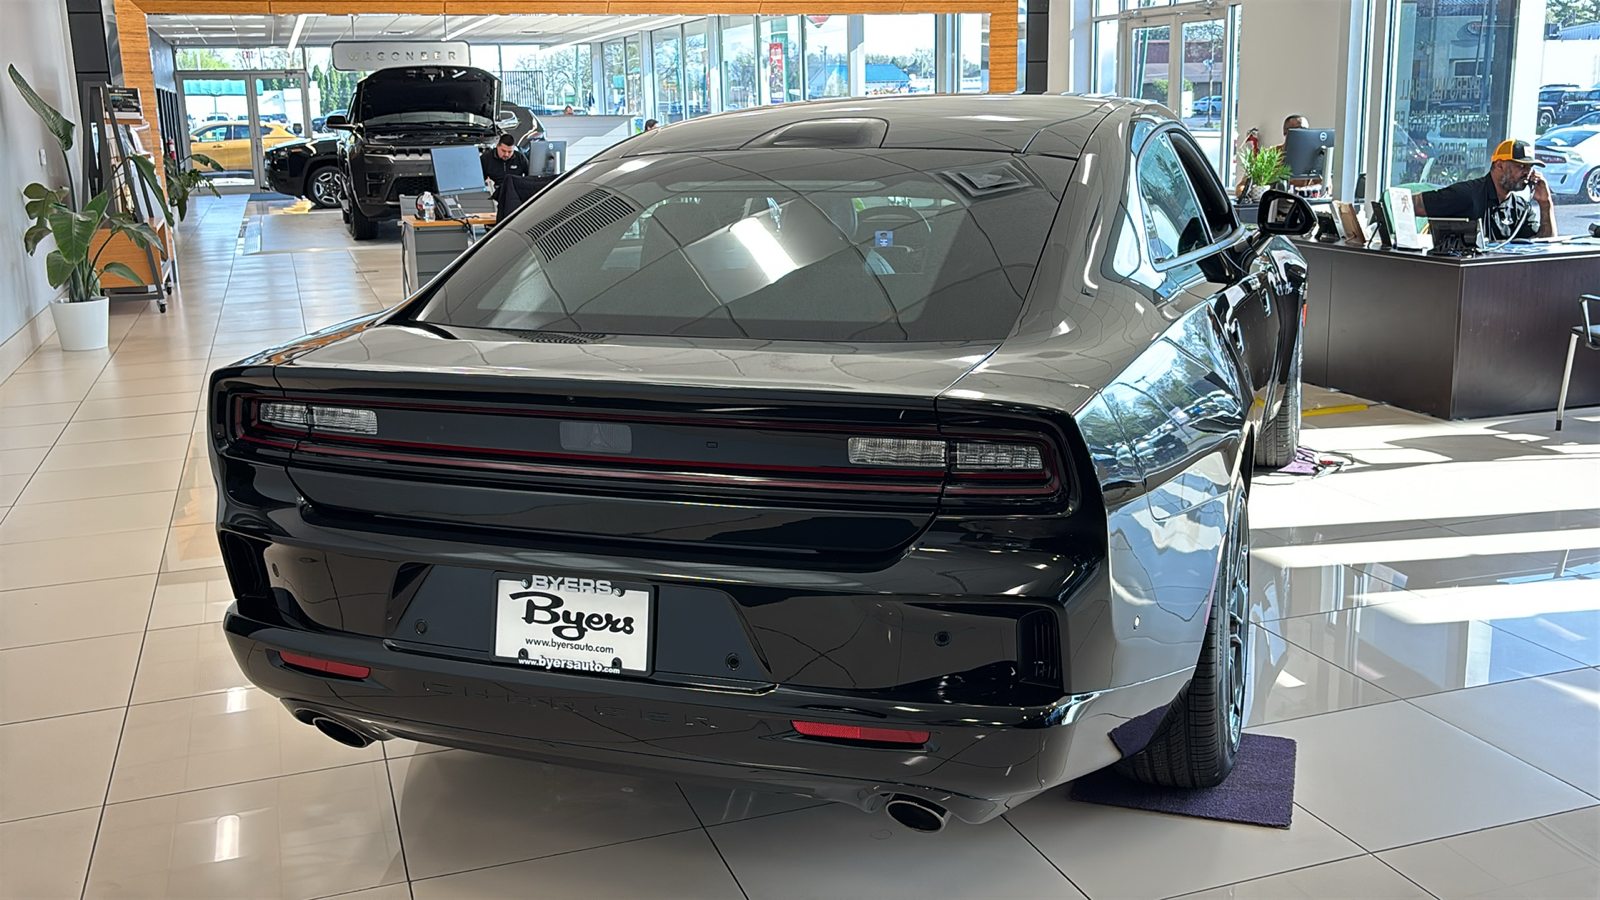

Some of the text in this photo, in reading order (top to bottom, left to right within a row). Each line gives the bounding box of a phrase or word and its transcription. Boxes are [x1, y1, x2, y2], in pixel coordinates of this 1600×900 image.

[532, 574, 613, 595] BYERS
[509, 591, 635, 641] Byers
[525, 637, 614, 654] www.byersauto.com
[518, 654, 621, 674] www.byersauto.com
[422, 681, 719, 729] CHARGER
